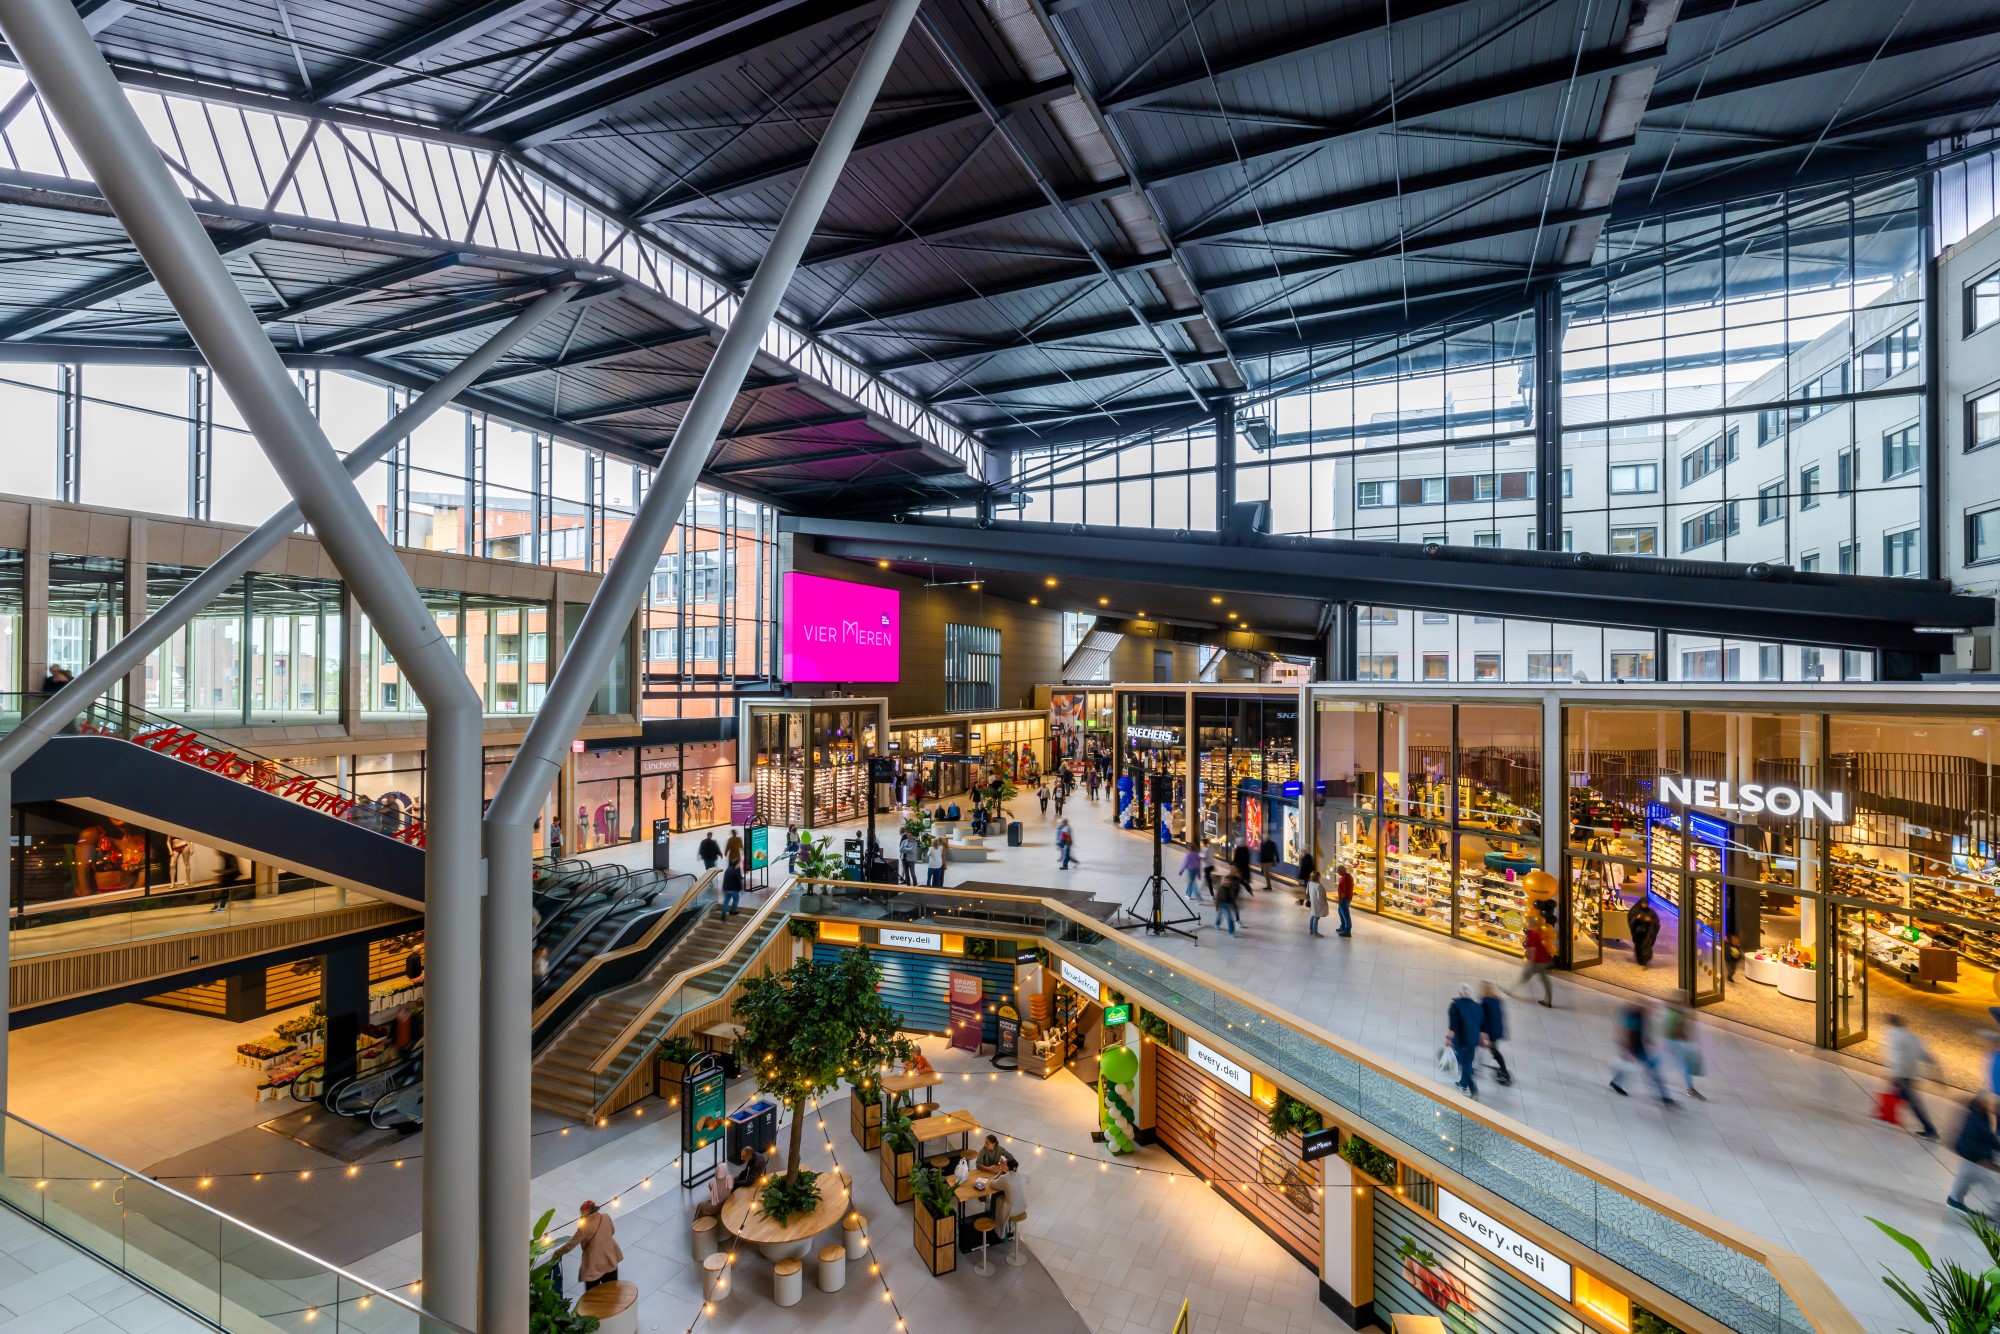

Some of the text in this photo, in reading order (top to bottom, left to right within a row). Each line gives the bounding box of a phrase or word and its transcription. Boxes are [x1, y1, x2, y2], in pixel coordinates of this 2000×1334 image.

[803, 625, 837, 642] VIER
[842, 620, 892, 646] MEREN
[1126, 726, 1173, 741] SKECHERS
[132, 726, 355, 818] Media Markt
[643, 760, 679, 771] Lincherie
[1659, 776, 1844, 822] NELSON
[890, 934, 931, 945] every.deli
[954, 978, 976, 987] GRAND
[954, 984, 977, 992] OPENING
[1198, 1050, 1239, 1081] every.deli
[1459, 1211, 1545, 1272] every.deli
